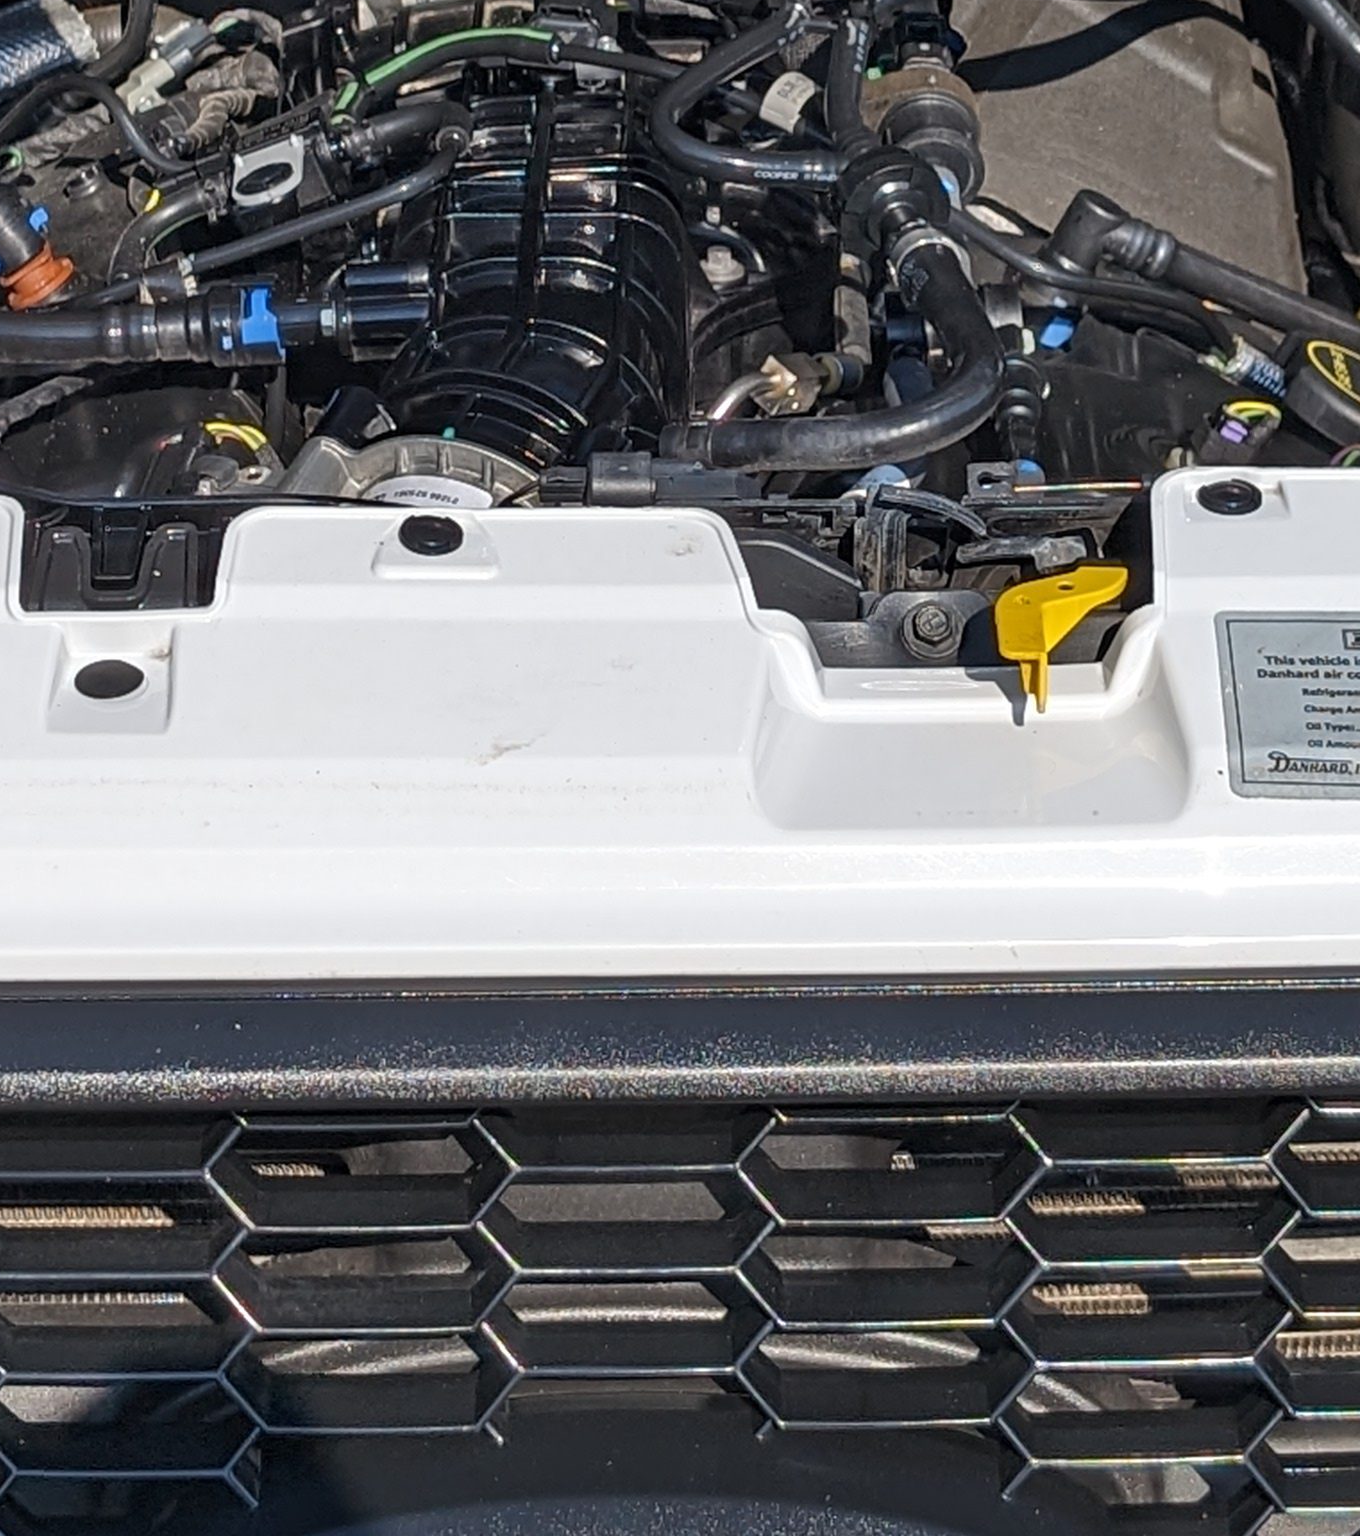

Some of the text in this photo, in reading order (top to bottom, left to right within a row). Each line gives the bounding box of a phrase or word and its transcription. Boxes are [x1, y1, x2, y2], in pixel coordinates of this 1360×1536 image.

[754, 170, 799, 180] COOPER
[1264, 655, 1296, 666] This
[1299, 655, 1350, 666] vehicle
[1257, 669, 1319, 679] Danhard
[1324, 668, 1343, 679] air
[1303, 704, 1343, 715] Charge
[1306, 722, 1355, 732] Oil Type:
[1308, 739, 1323, 748] Oil
